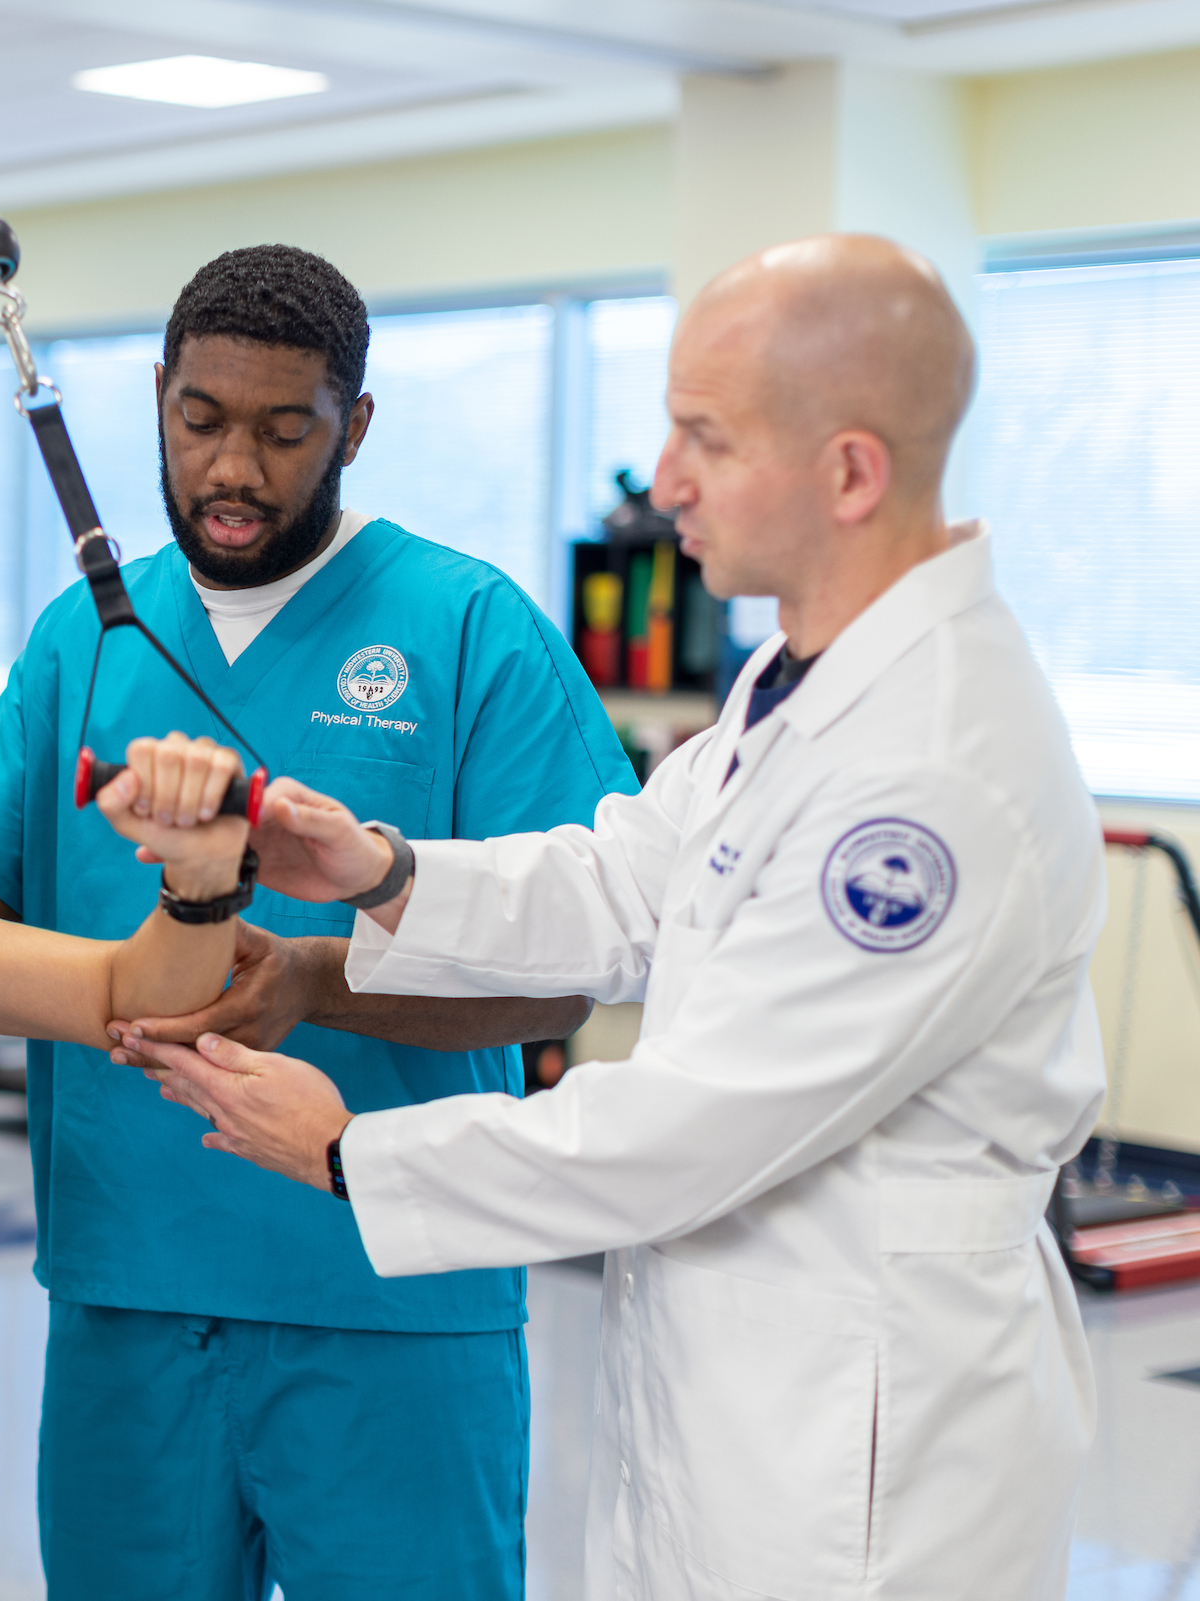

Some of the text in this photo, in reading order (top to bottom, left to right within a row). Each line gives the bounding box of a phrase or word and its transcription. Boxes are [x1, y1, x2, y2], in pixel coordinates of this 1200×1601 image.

[344, 648, 405, 675] MIDWESTERN UNIVERSITY
[341, 678, 352, 700] COLLEGE
[384, 681, 404, 704] SCIENCES
[311, 711, 418, 735] Physical Therapy
